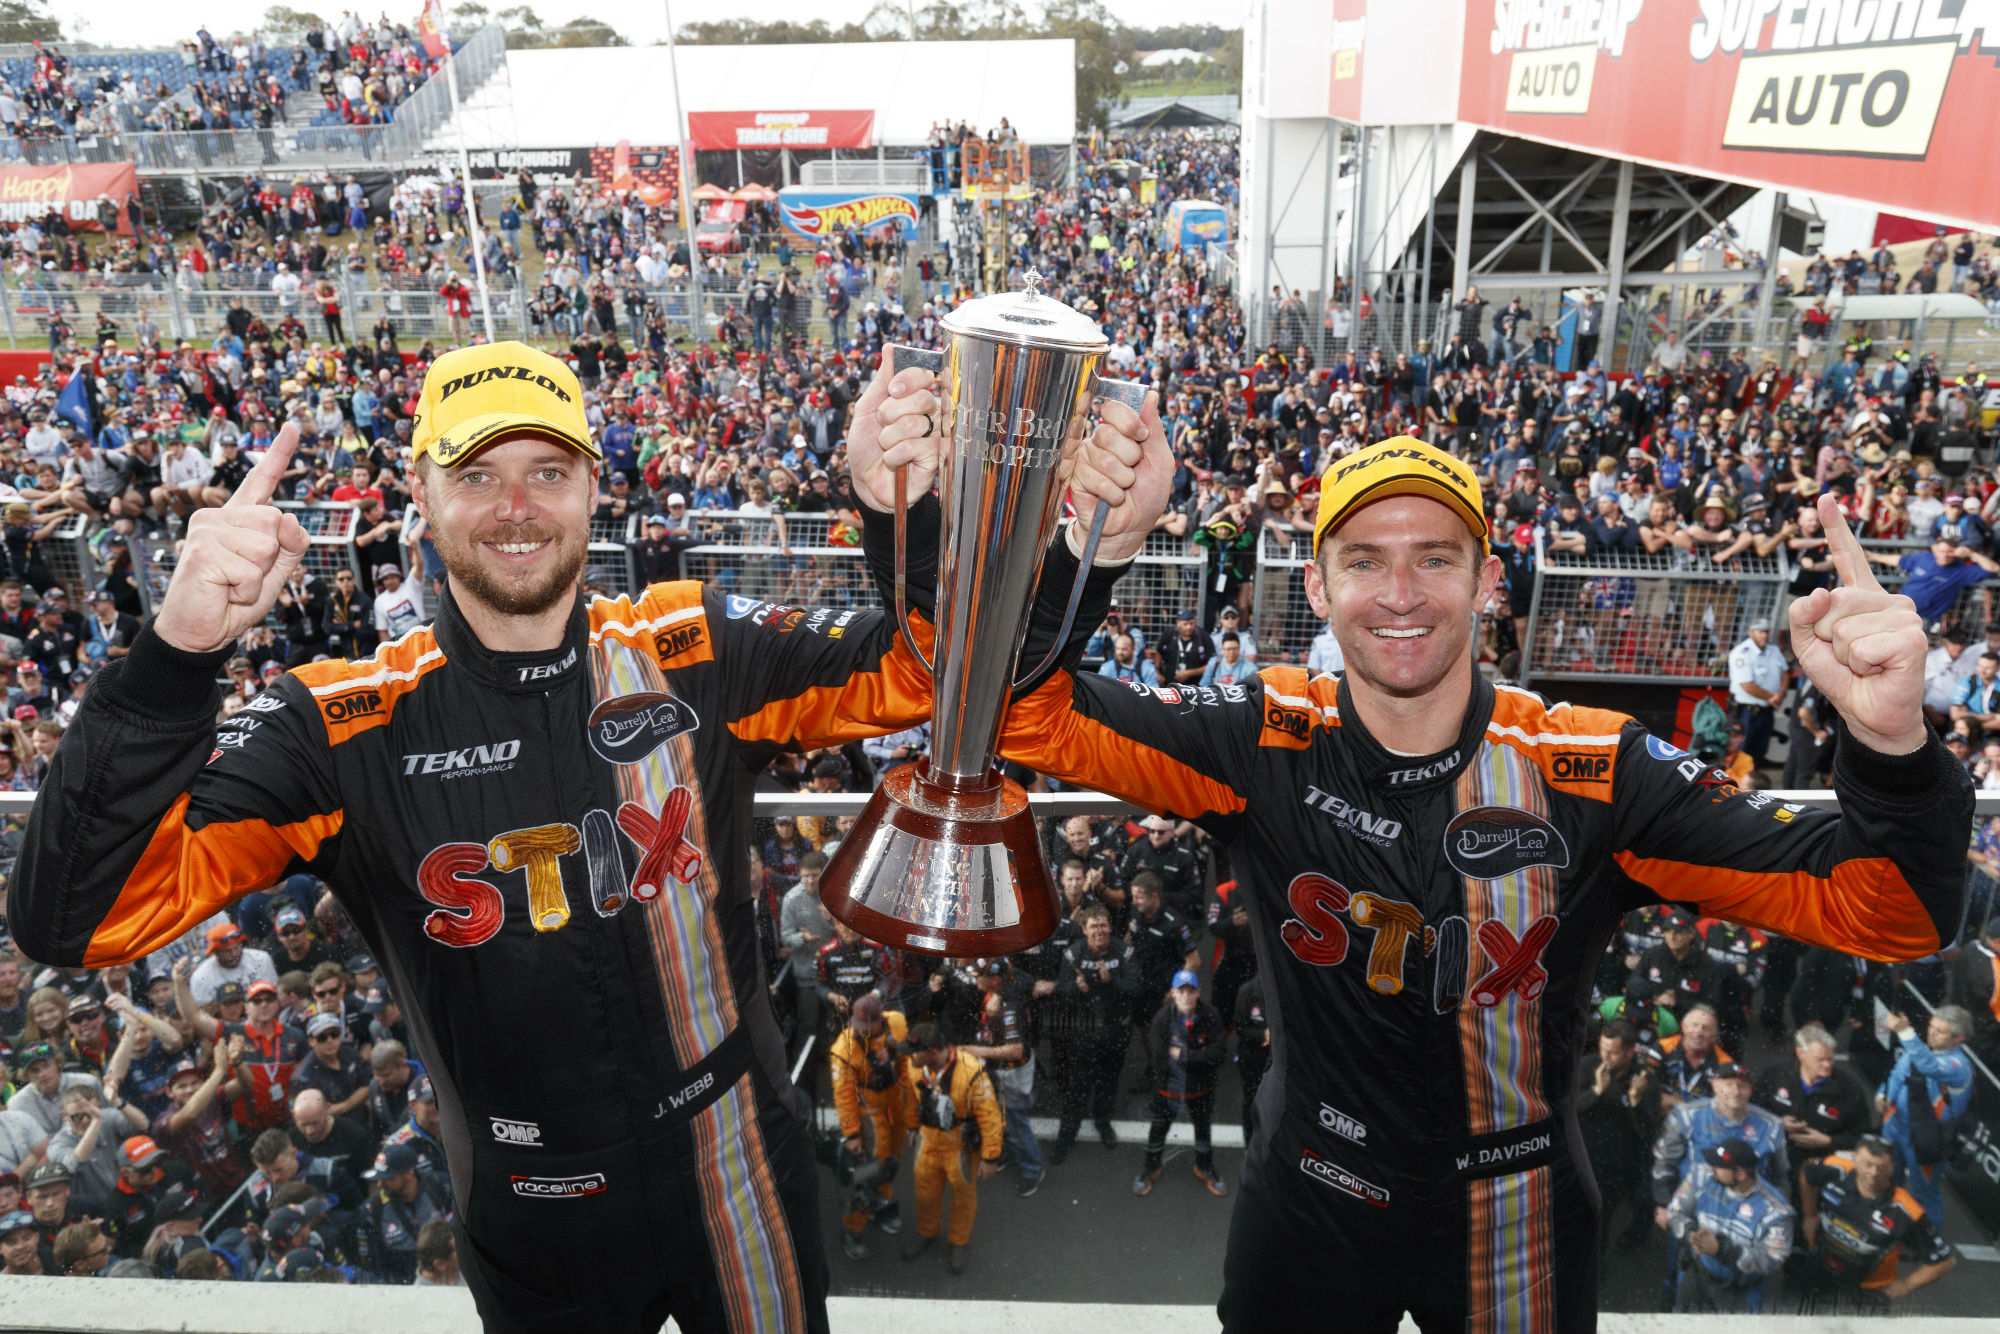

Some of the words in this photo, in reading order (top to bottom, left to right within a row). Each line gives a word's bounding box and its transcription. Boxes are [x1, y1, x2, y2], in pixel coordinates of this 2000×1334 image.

[1517, 61, 1581, 97] AUTO
[1748, 69, 1910, 127] AUTO
[441, 366, 571, 403] DUNLOP
[1335, 448, 1468, 489] DUNLOP
[655, 625, 701, 657] OMP
[517, 647, 577, 684] TEKNO
[325, 693, 382, 719] OMP
[601, 711, 647, 744] Darrell
[646, 708, 676, 728] Lea
[402, 739, 521, 775] TEKNO
[441, 762, 517, 781] PERFORMANCE
[1387, 751, 1461, 784] TEKNO
[1552, 757, 1610, 778] OMP
[1303, 785, 1402, 840] TEKNO
[1457, 830, 1512, 855] Darrell
[1515, 829, 1546, 849] Lea
[417, 785, 703, 947] STIX
[1281, 872, 1560, 1015] STIX
[653, 1103, 668, 1119] J.
[668, 1072, 715, 1109] WEBB
[491, 1122, 542, 1142] OMP
[1319, 1107, 1367, 1140] OMP
[1455, 1154, 1475, 1171] W.
[1479, 1133, 1551, 1164] DAVISON
[518, 1178, 599, 1194] raceline
[1305, 1156, 1384, 1200] raceline
